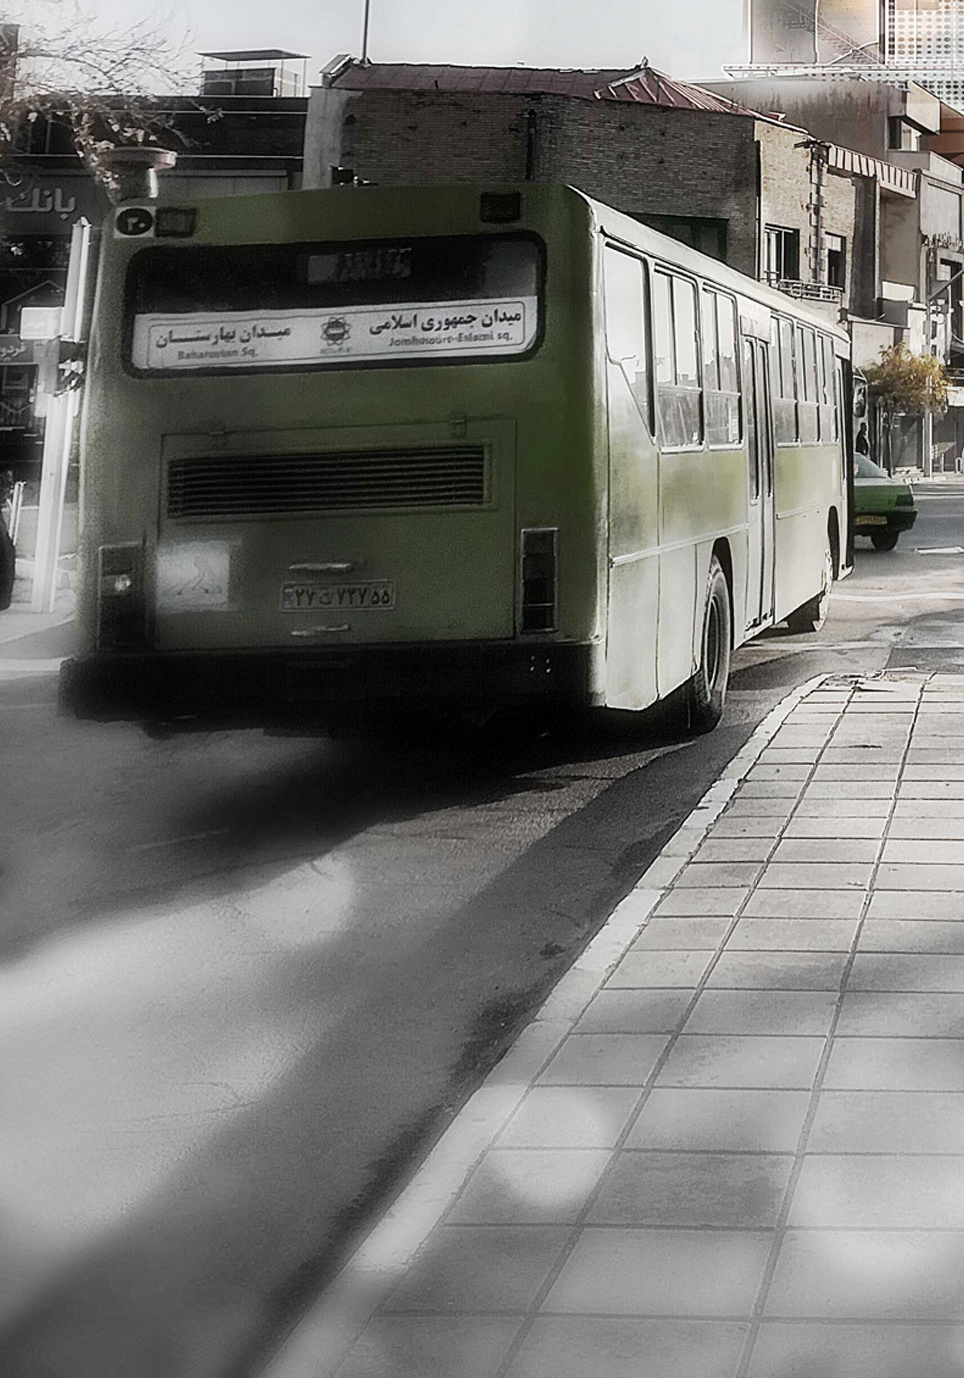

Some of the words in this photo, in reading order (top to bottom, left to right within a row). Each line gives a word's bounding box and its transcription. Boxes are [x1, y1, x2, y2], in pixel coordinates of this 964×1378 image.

[369, 313, 418, 335] اسلامی
[420, 313, 478, 332] جمهوری
[481, 309, 521, 328] میدان
